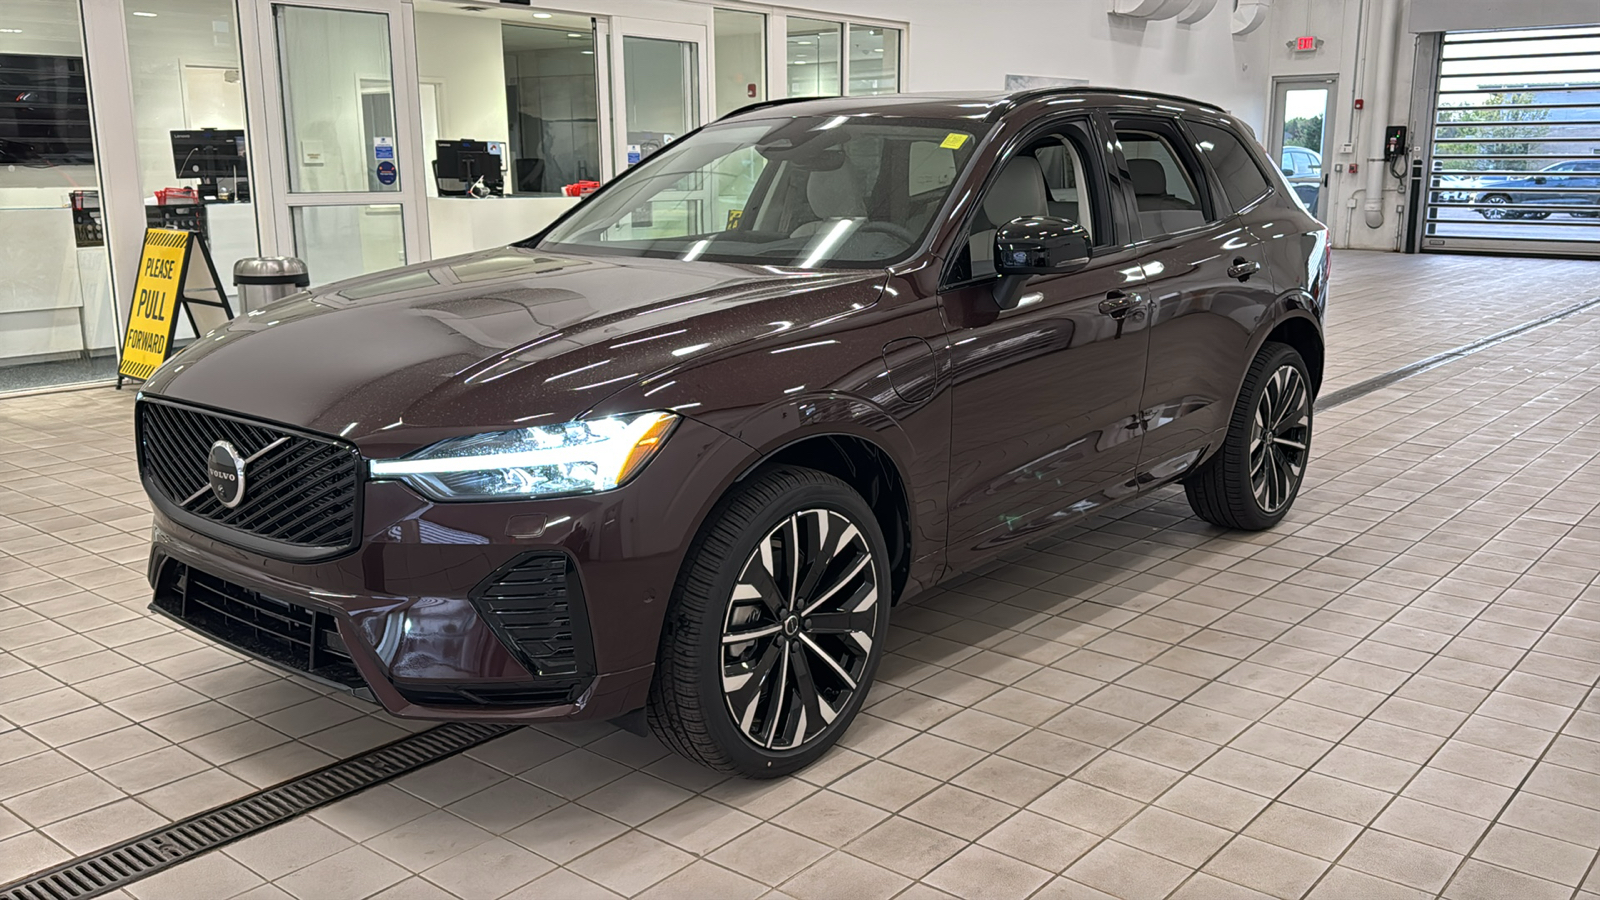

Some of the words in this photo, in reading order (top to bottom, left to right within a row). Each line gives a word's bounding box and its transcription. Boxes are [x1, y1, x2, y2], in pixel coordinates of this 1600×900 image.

[144, 257, 175, 280] PLEASE
[136, 288, 166, 321] PULL
[126, 328, 165, 354] FORWARD
[209, 468, 235, 482] VOLVO
